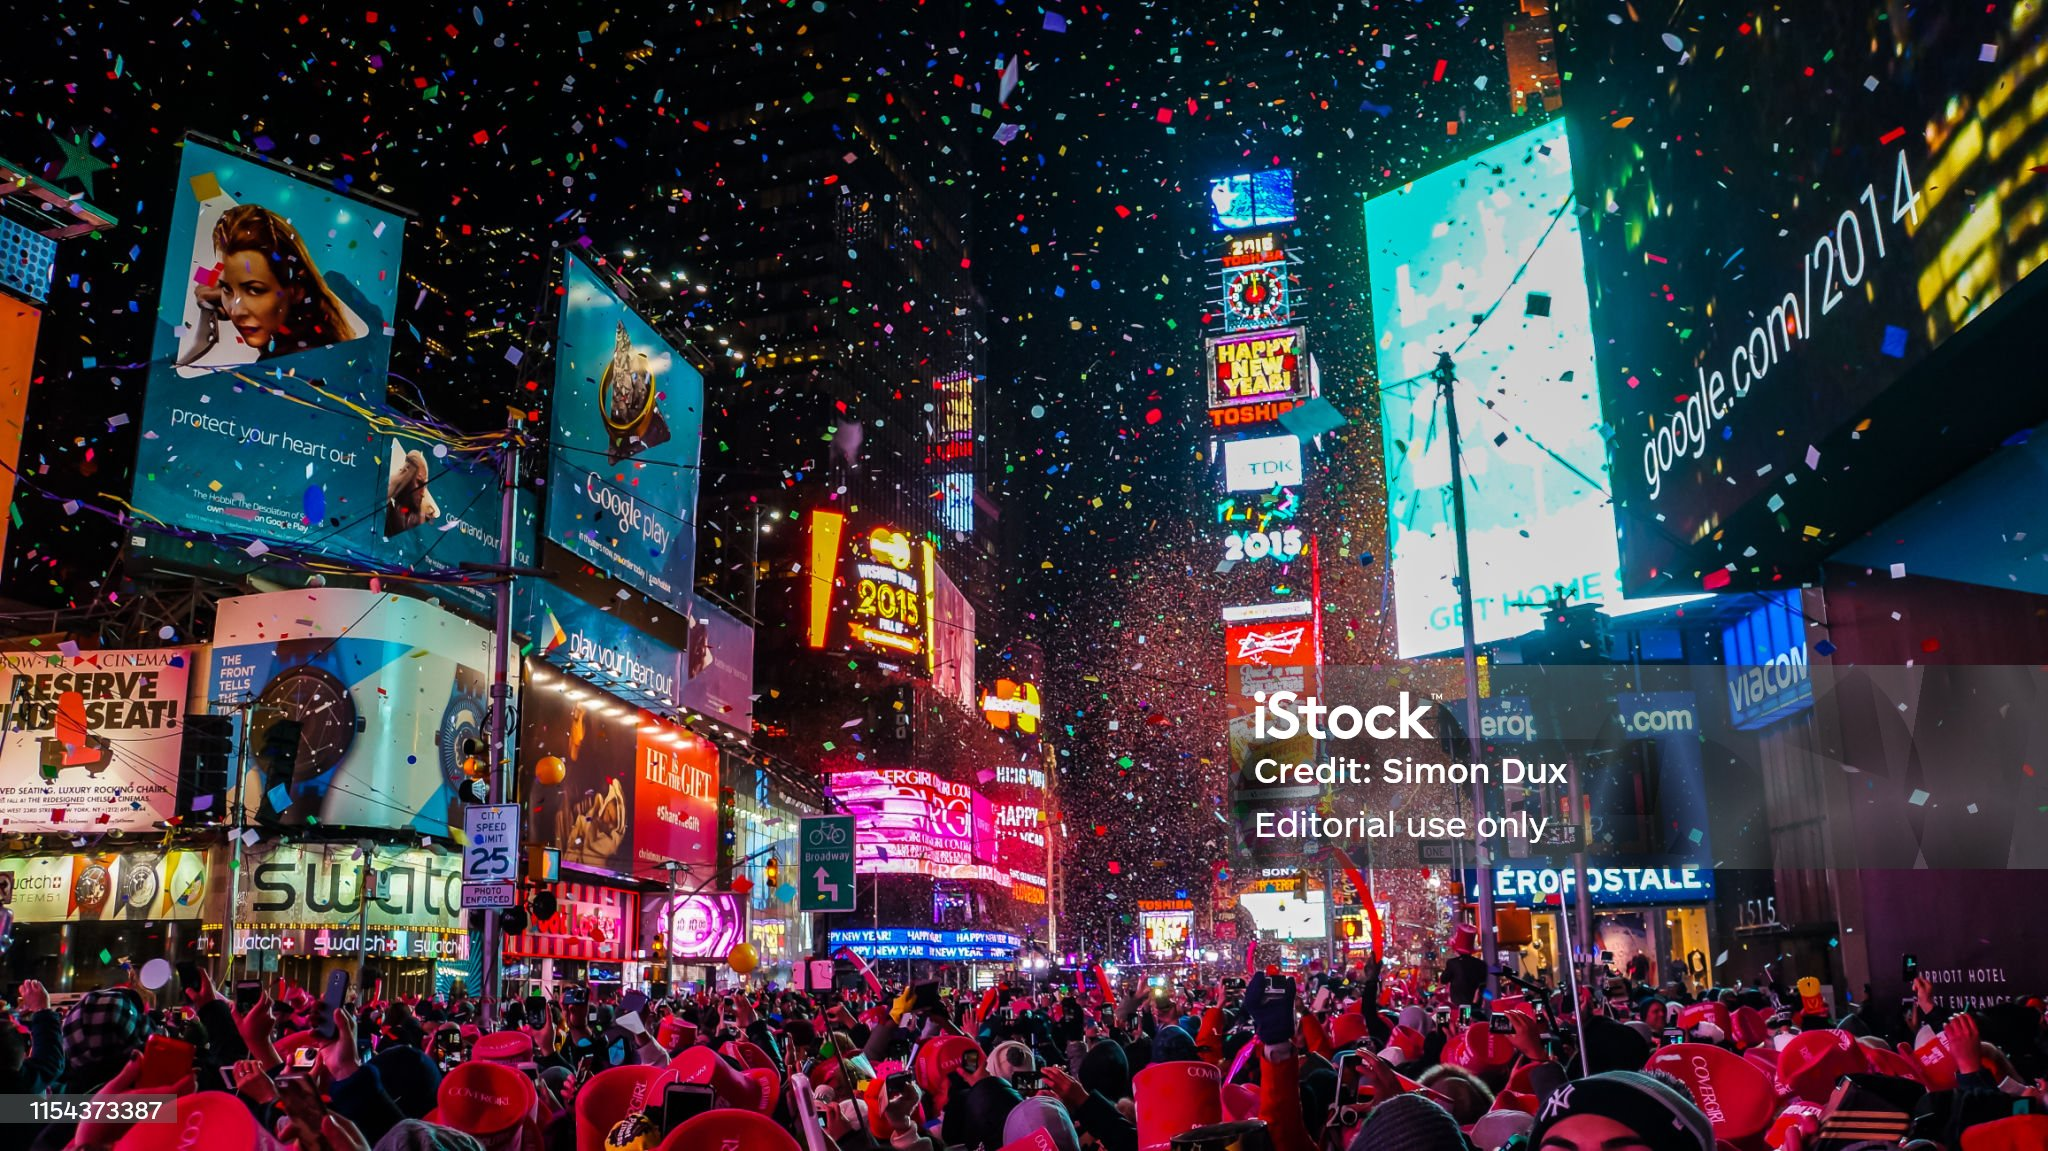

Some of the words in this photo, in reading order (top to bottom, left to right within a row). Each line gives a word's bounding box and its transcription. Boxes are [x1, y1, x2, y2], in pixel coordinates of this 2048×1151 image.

[1232, 237, 1274, 256] 2015
[1222, 250, 1285, 268] TOSHIBA
[1644, 149, 1920, 499] google.com/2014
[1217, 336, 1296, 364] HAPPY
[1230, 355, 1284, 380] NEW
[1223, 371, 1291, 398] YEAR!
[1208, 401, 1305, 427] TOSHI
[171, 408, 236, 437] protect
[239, 425, 279, 446] your
[282, 434, 326, 460] heart
[329, 448, 357, 468] out
[1248, 459, 1293, 476] TDK
[587, 472, 642, 533] Google
[643, 514, 670, 554] play
[265, 516, 293, 530] Googe
[1225, 529, 1302, 561] 2015
[857, 579, 919, 626] 2015
[1429, 598, 1493, 632] GET
[1503, 571, 1602, 617] HOME
[221, 655, 241, 666] THE
[570, 629, 597, 657] play
[599, 645, 624, 672] your
[625, 657, 655, 692] heart
[656, 673, 673, 697] out
[220, 666, 256, 677] FRONT
[10, 672, 159, 701] RESERVE
[219, 679, 250, 691] TELLS
[218, 692, 238, 704] THE
[0, 702, 57, 731] HIS
[86, 700, 178, 730] SEAT!
[645, 747, 668, 786] HE
[59, 786, 91, 794] LUXURY
[94, 785, 133, 794] ROCKING
[681, 763, 712, 802] GIFT
[29, 796, 40, 804] THE
[43, 796, 84, 804] REDESIGNED
[481, 811, 503, 820] CITY
[996, 805, 1038, 828] HAPPY
[475, 823, 507, 832] SPEED
[476, 834, 504, 844] IMIT
[805, 851, 850, 863] Broadway
[1426, 847, 1445, 857] ONE
[470, 847, 509, 875] 25
[1262, 868, 1298, 877] SONY
[1473, 863, 1702, 897] ÉROPOSTALE
[253, 857, 462, 919] swatc
[474, 887, 502, 895] PHOTO
[465, 895, 510, 904] ENFORCED
[1137, 898, 1193, 910] TOSHIBA
[1738, 896, 1776, 927] 1515
[234, 934, 282, 951] watch
[314, 935, 385, 951] swatch
[842, 931, 860, 942] NEW
[862, 930, 892, 942] YEAR!
[956, 932, 985, 943] HAPPY
[414, 938, 458, 954] swatch
[849, 946, 871, 956] APPY
[873, 946, 898, 956] NEW
[1919, 969, 1962, 983] RRIOTT
[1968, 968, 2007, 982] HOTEL
[1691, 1055, 1728, 1125] COVERGIRL
